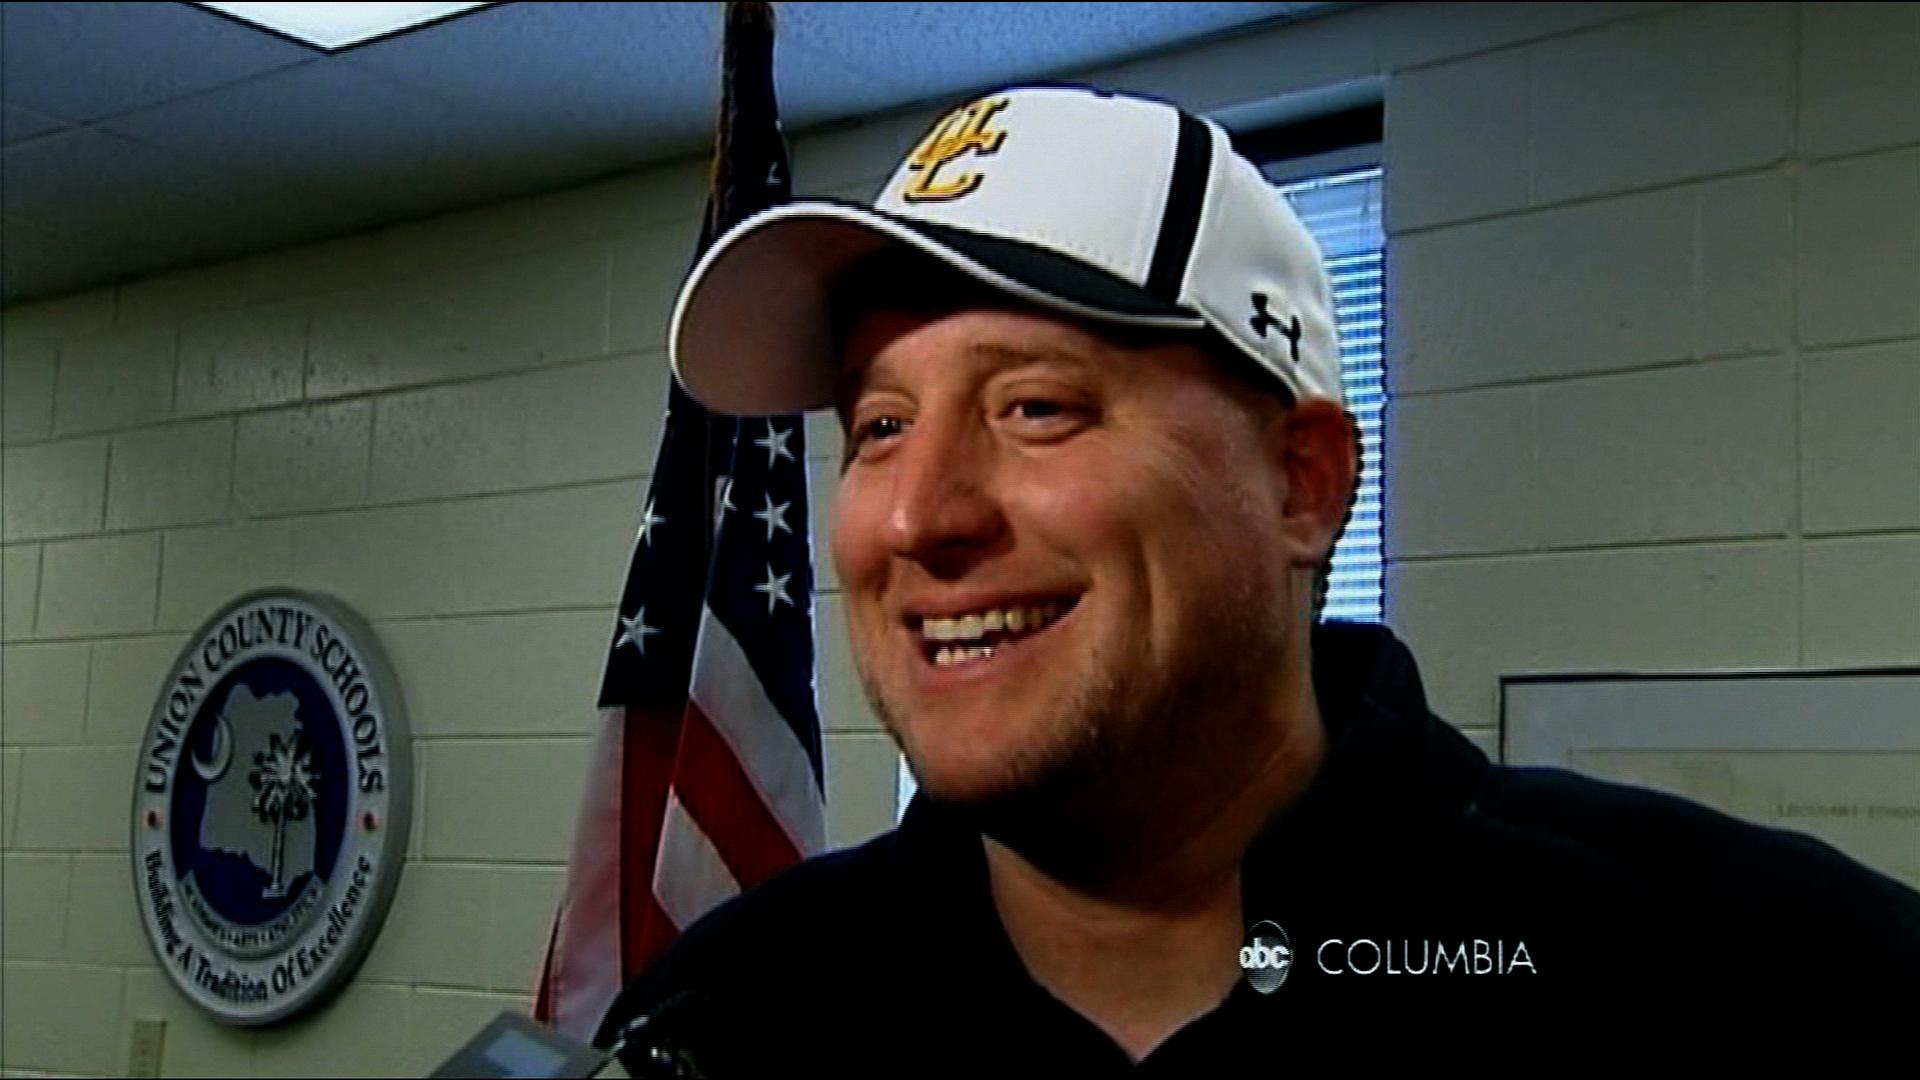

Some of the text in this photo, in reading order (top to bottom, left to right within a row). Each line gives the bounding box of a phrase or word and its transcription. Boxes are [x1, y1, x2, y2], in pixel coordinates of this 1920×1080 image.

[145, 607, 384, 794] UNION COUNTY SCHOOLS
[145, 850, 181, 956] Building
[178, 946, 193, 971] A
[195, 955, 268, 1002] Tradition
[271, 954, 297, 994] Of
[296, 854, 371, 977] Excellence
